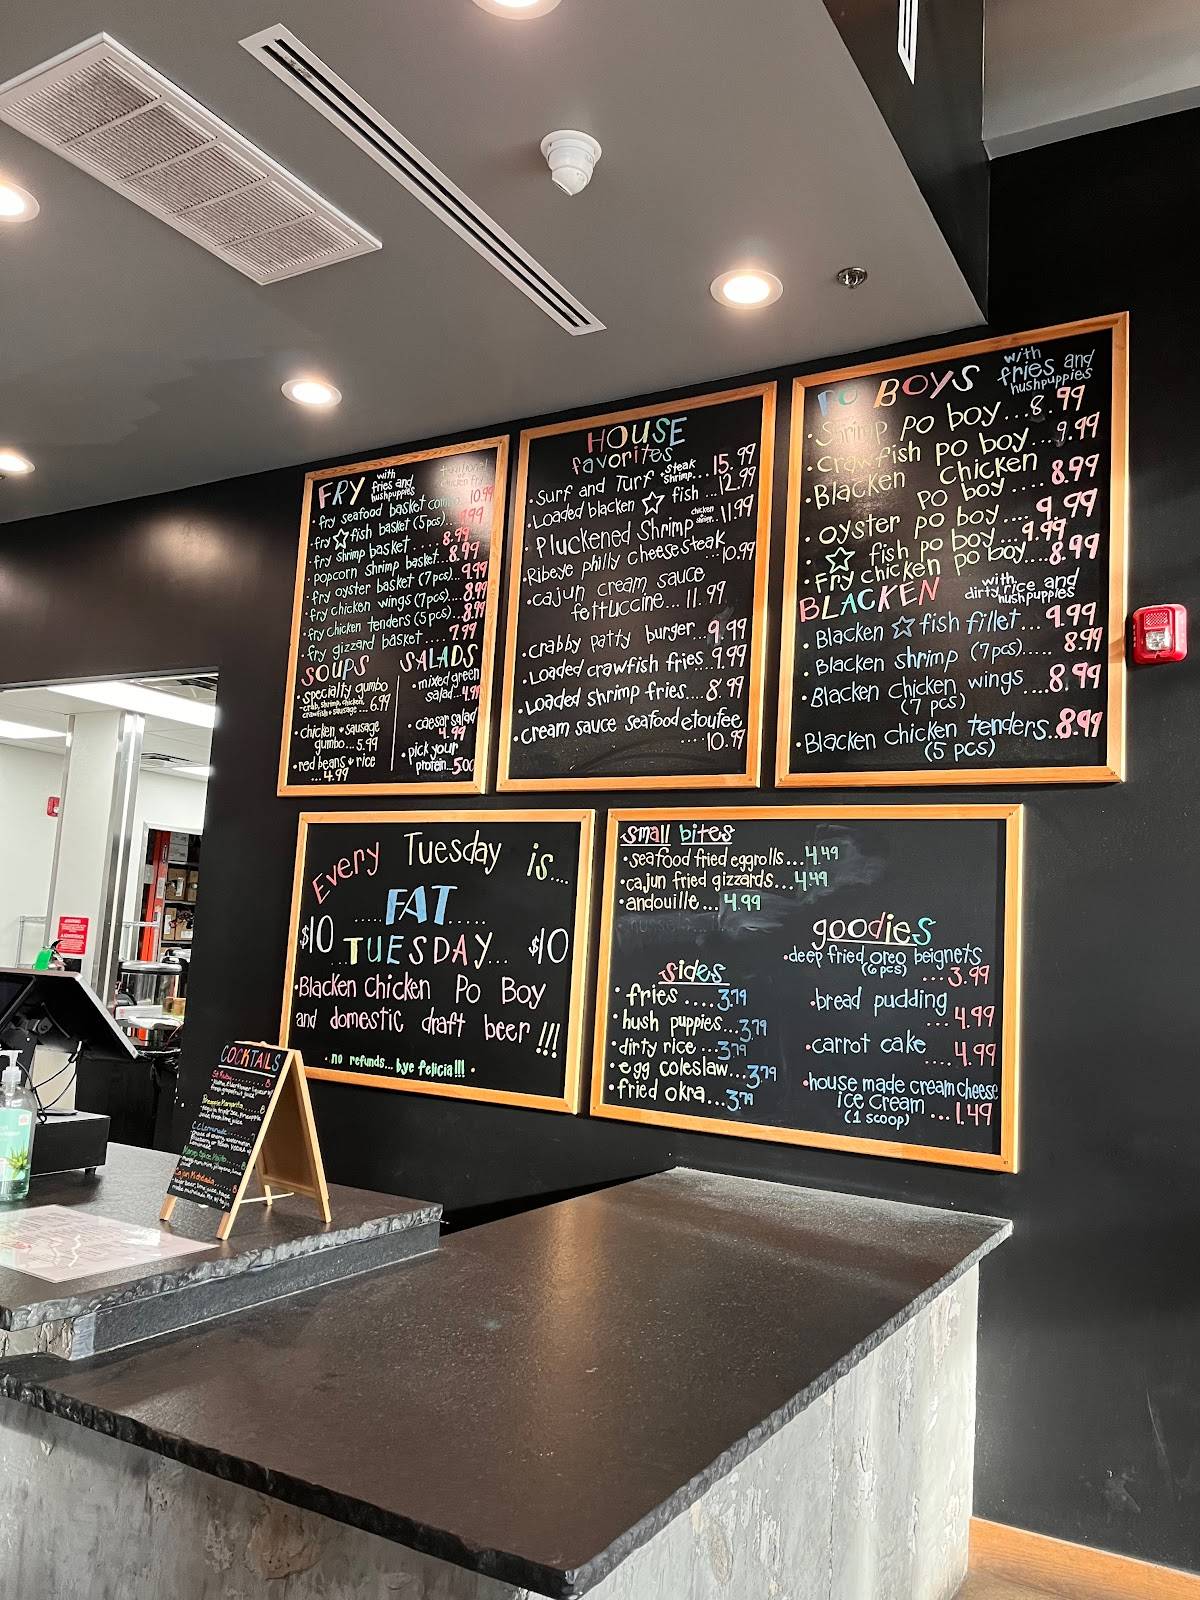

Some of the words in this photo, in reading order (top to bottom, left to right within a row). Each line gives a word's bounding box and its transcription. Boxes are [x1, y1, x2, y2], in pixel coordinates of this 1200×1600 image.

[997, 360, 1054, 386] fries
[1064, 349, 1095, 368] and
[1004, 346, 1041, 363] with
[874, 365, 980, 409] BOYS
[1011, 367, 1093, 395] hushpuppies
[947, 402, 1001, 431] boy
[588, 417, 688, 453] HOUSE
[979, 428, 1028, 454] boy
[1057, 411, 1099, 443] 9.99
[572, 444, 673, 474] favorites
[713, 443, 756, 475] 15.99
[1052, 454, 1099, 484] 8.99
[372, 480, 393, 493] fries
[395, 475, 414, 487] and
[377, 470, 395, 479] with
[579, 481, 605, 497] and
[616, 470, 654, 492] Turf
[318, 477, 365, 509] FRY
[371, 487, 415, 502] hushpuppies
[532, 501, 584, 529] Loaded
[588, 500, 635, 518] blacken
[672, 486, 699, 503] fish
[719, 466, 756, 495] 12.99
[961, 478, 1005, 501] boy
[319, 516, 335, 530] fry
[341, 504, 382, 524] seafood
[390, 495, 426, 517] basket
[957, 504, 1000, 527] boy
[315, 537, 331, 550] fry
[351, 524, 372, 541] fish
[379, 518, 410, 536] basket
[537, 521, 631, 558] Pluckened
[721, 494, 754, 523] 11.99
[314, 555, 332, 568] fry
[336, 547, 365, 563] shrimp
[370, 535, 410, 559] basket
[869, 539, 909, 566] fish
[1021, 517, 1067, 542] 9.99
[1049, 532, 1099, 565] 8.99
[314, 567, 357, 586] popcorn
[365, 560, 399, 578] shrimp
[406, 549, 439, 570] basket
[527, 563, 573, 586] Ribeye
[582, 552, 621, 579] philly
[722, 542, 755, 564] 10.99
[965, 584, 999, 601] dirty
[1003, 580, 1035, 594] rice
[1044, 567, 1080, 588] and
[982, 573, 1017, 586] with
[312, 591, 331, 605] fry
[335, 583, 371, 600] oyster
[378, 593, 411, 611] wings
[571, 593, 664, 621] fettuccine
[687, 581, 726, 608] 11.99
[800, 577, 939, 622] BLACKEN
[368, 614, 410, 632] tenders
[645, 621, 695, 644] burger
[816, 622, 883, 650] Blacken
[919, 612, 960, 634] fish
[967, 611, 1021, 634] fillet
[332, 637, 374, 660] gizzard
[449, 622, 477, 641] 7.99
[301, 655, 369, 687] SOUPS
[400, 644, 478, 672] SALADS
[529, 659, 584, 685] Loaded
[587, 654, 658, 678] crawfish
[666, 651, 703, 672] fries
[816, 655, 884, 676] Blacken
[302, 683, 352, 704] specialty
[356, 678, 388, 699] gumbo
[418, 676, 449, 690] mixed
[451, 667, 479, 688] green
[968, 668, 1023, 695] wings
[370, 694, 391, 712] 6.99
[425, 687, 453, 702] salad
[526, 687, 581, 715] Loaded
[645, 681, 687, 700] fries
[346, 721, 380, 736] sausage
[416, 715, 449, 730] caesar
[451, 707, 477, 726] salad
[681, 707, 742, 731] etoufee
[315, 739, 345, 755] gumbo
[356, 737, 379, 752] 5.99
[439, 726, 466, 740] 4.99
[707, 729, 745, 751] 10.99
[299, 758, 316, 772] red
[318, 755, 346, 770] beans
[356, 753, 376, 768] rice
[408, 744, 429, 765] pick
[431, 741, 458, 760] your
[323, 767, 349, 782] 4.99
[416, 758, 447, 775] protein
[620, 824, 670, 844] small
[680, 824, 735, 843] bites
[312, 841, 380, 904] Every
[404, 830, 502, 875] Tuesday
[629, 847, 691, 868] seafood
[694, 847, 728, 868] fried
[731, 848, 784, 872] eggrolls
[805, 846, 839, 866] 4.49
[672, 871, 706, 889] fried
[712, 870, 774, 891] gizzards
[794, 870, 828, 891] 4.49
[625, 892, 699, 911] andouille
[300, 915, 334, 953] $10
[528, 927, 569, 964] $10
[812, 912, 936, 950] goodies
[789, 946, 822, 968] deep
[827, 945, 864, 965] fried
[914, 944, 983, 970] beignets
[658, 959, 726, 983] sides
[948, 965, 989, 987] 3.99
[502, 976, 546, 1010] Boy
[816, 986, 862, 1010] bread
[874, 989, 947, 1017] pudding
[330, 1006, 403, 1032] domestic
[422, 1007, 466, 1037] draft
[484, 1014, 530, 1043] beer
[623, 1009, 659, 1032] hush
[671, 1014, 723, 1037] puppies
[619, 1038, 657, 1058] dirty
[664, 1038, 696, 1054] rice
[812, 1033, 870, 1054] carrot
[880, 1030, 926, 1053] cake
[220, 1045, 281, 1072] COCKTAILS
[331, 1053, 342, 1064] no
[396, 1058, 414, 1074] bye
[619, 1062, 649, 1080] egg
[660, 1056, 728, 1077] coleslaw
[617, 1078, 658, 1100] fried
[665, 1080, 704, 1103] okra
[809, 1072, 857, 1091] house
[863, 1073, 905, 1094] made
[838, 1091, 864, 1109] ice
[956, 1102, 992, 1125] 1.49
